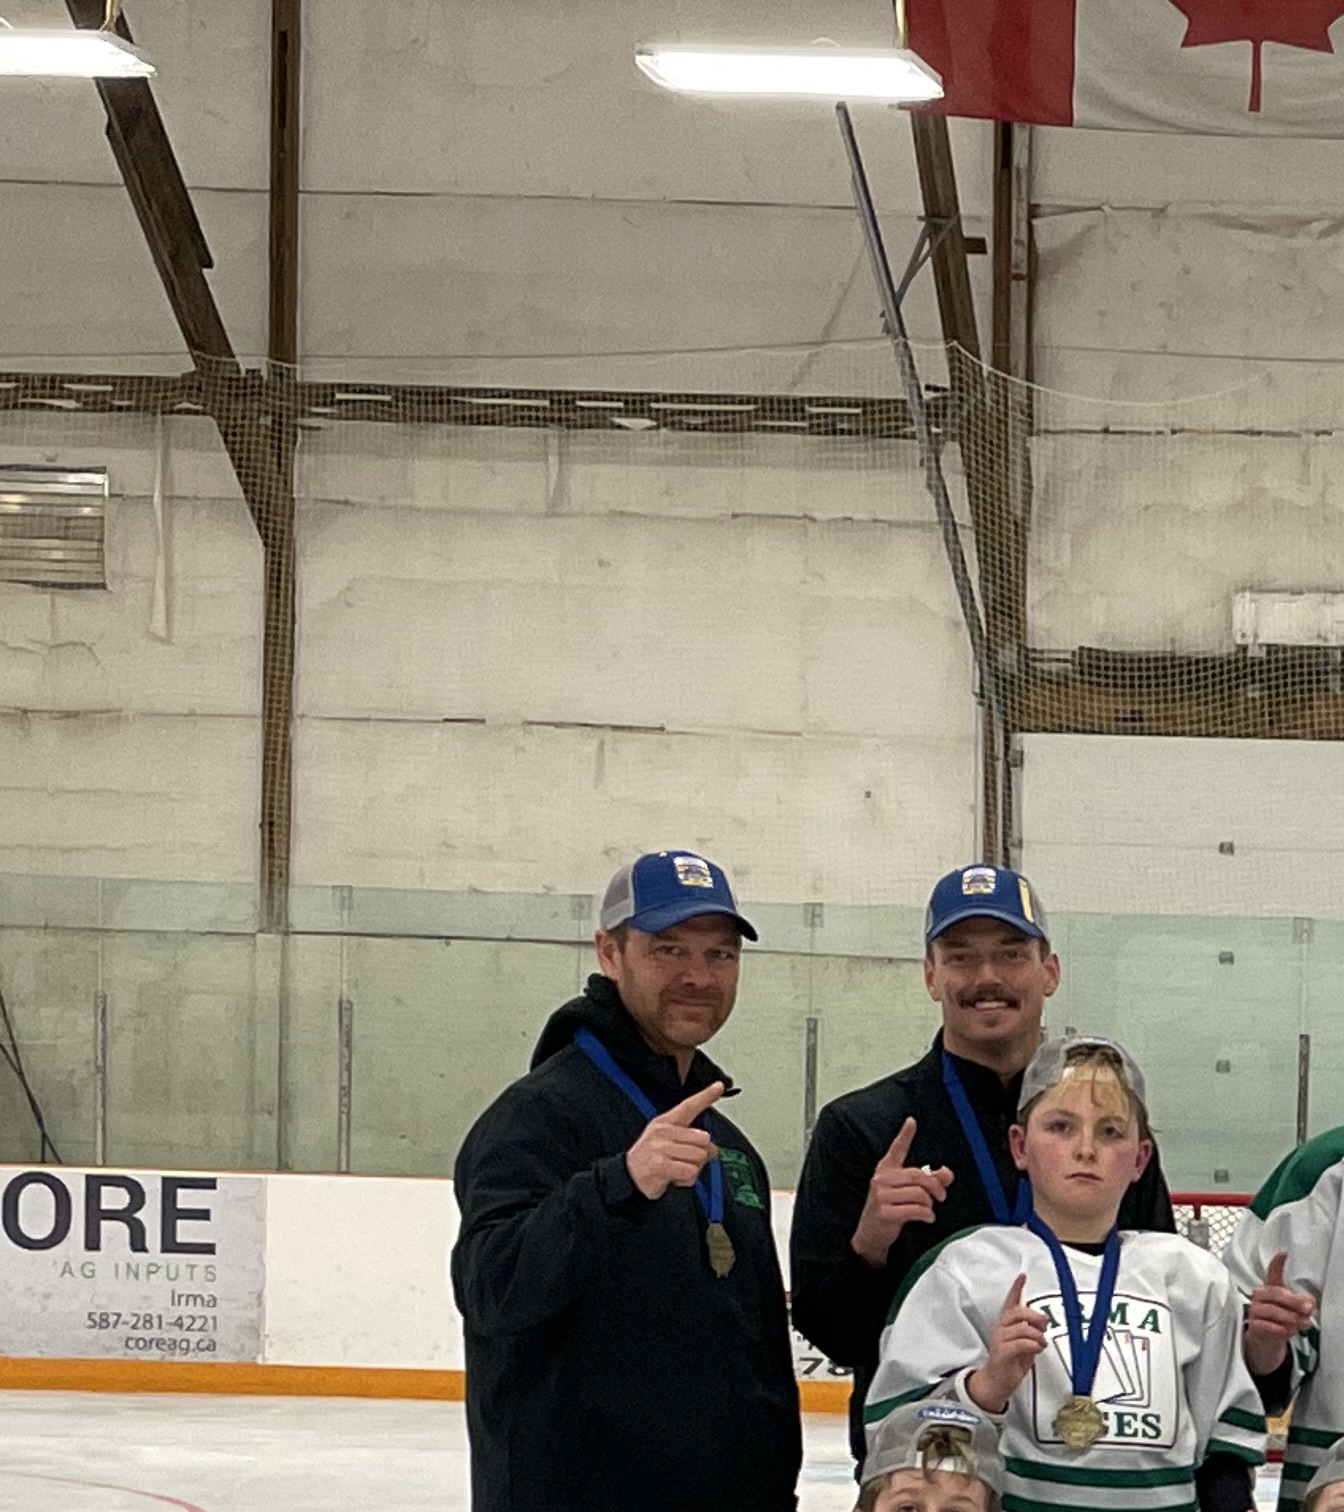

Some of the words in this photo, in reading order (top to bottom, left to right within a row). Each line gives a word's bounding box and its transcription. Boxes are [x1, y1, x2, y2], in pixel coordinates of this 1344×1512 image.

[2, 1171, 218, 1256] ORE
[59, 1261, 97, 1279] AG
[113, 1262, 217, 1283] INPUTS
[170, 1289, 218, 1309] Irma
[86, 1311, 218, 1333] 587-281-4221
[124, 1335, 217, 1356] coreag.ca
